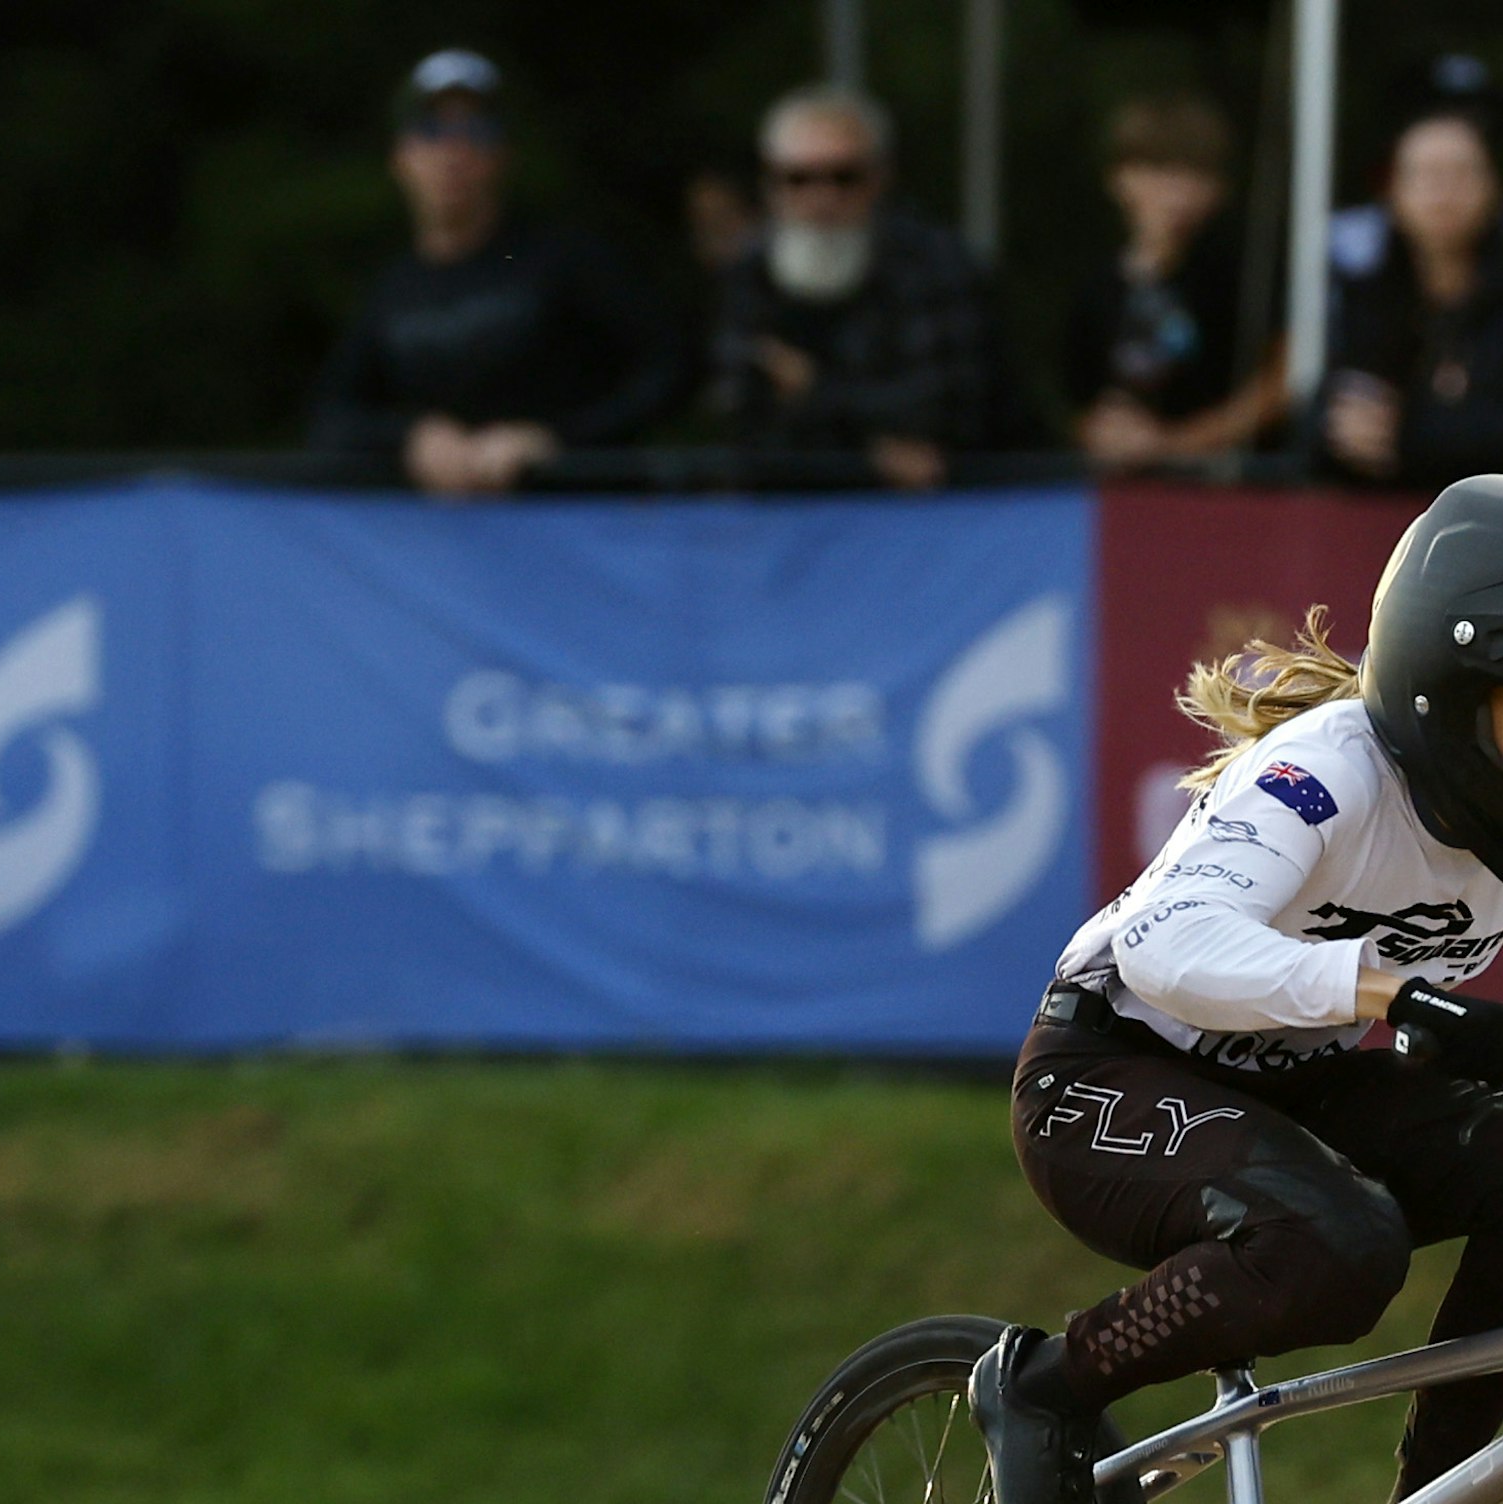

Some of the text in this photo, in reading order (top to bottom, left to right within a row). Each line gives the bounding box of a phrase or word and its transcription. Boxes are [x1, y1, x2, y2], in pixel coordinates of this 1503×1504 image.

[443, 669, 884, 763] GREATER
[254, 781, 889, 876] SHEPPARTON
[1040, 1081, 1244, 1157] FLY
